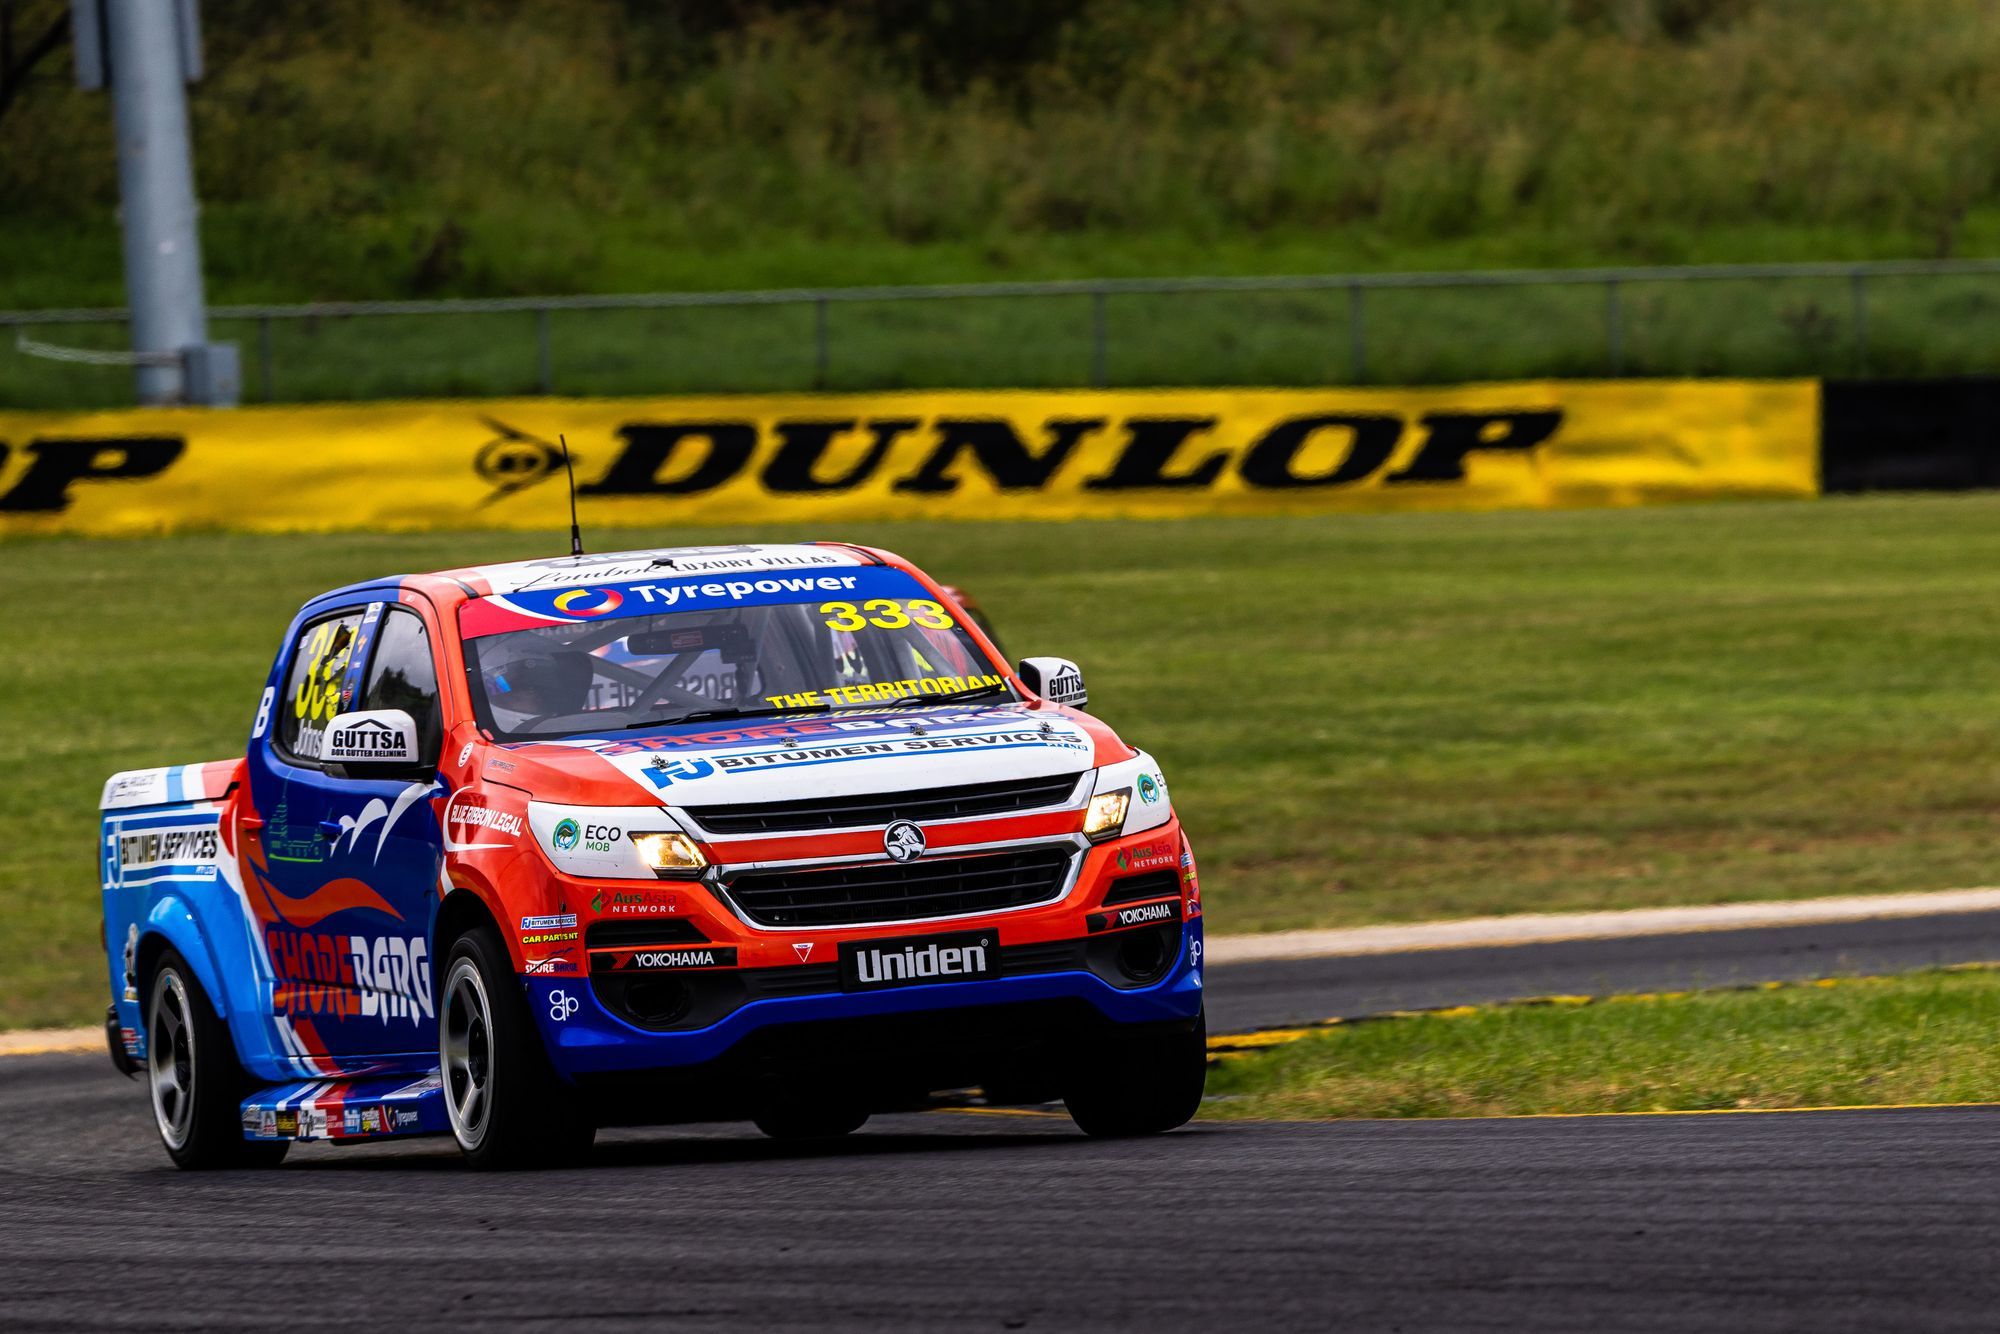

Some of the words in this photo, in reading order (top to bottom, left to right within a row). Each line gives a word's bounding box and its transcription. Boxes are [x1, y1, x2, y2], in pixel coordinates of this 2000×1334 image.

[580, 408, 1564, 498] DUNLOP
[0, 437, 187, 513] P
[679, 559, 754, 573] LUXURY
[761, 555, 838, 567] VILLAS
[628, 574, 857, 606] Tyrepower
[819, 599, 954, 632] 333
[765, 692, 821, 710] THE
[823, 674, 1007, 706] TERRITORIAN
[332, 730, 406, 749] GUTTSA
[346, 748, 372, 757] GUTTER
[374, 748, 407, 757] RELINING
[641, 757, 715, 789] FJ
[717, 743, 890, 769] BITUMEN
[903, 732, 1083, 751] SERVICES
[450, 804, 469, 824] BLUE
[466, 806, 493, 827] RIBBON
[490, 811, 523, 838] LEGAL
[585, 825, 622, 841] ECO
[586, 841, 610, 852] MOB
[1134, 855, 1174, 869] NETWORK
[612, 905, 676, 913] NETWORK
[1119, 904, 1172, 925] YOKOHAMA
[521, 918, 531, 929] FJ
[531, 918, 555, 927] BITUMEN
[522, 935, 541, 944] CAR
[543, 933, 568, 943] PARTS
[569, 932, 579, 940] NT
[635, 951, 715, 968] YOKOHAMA
